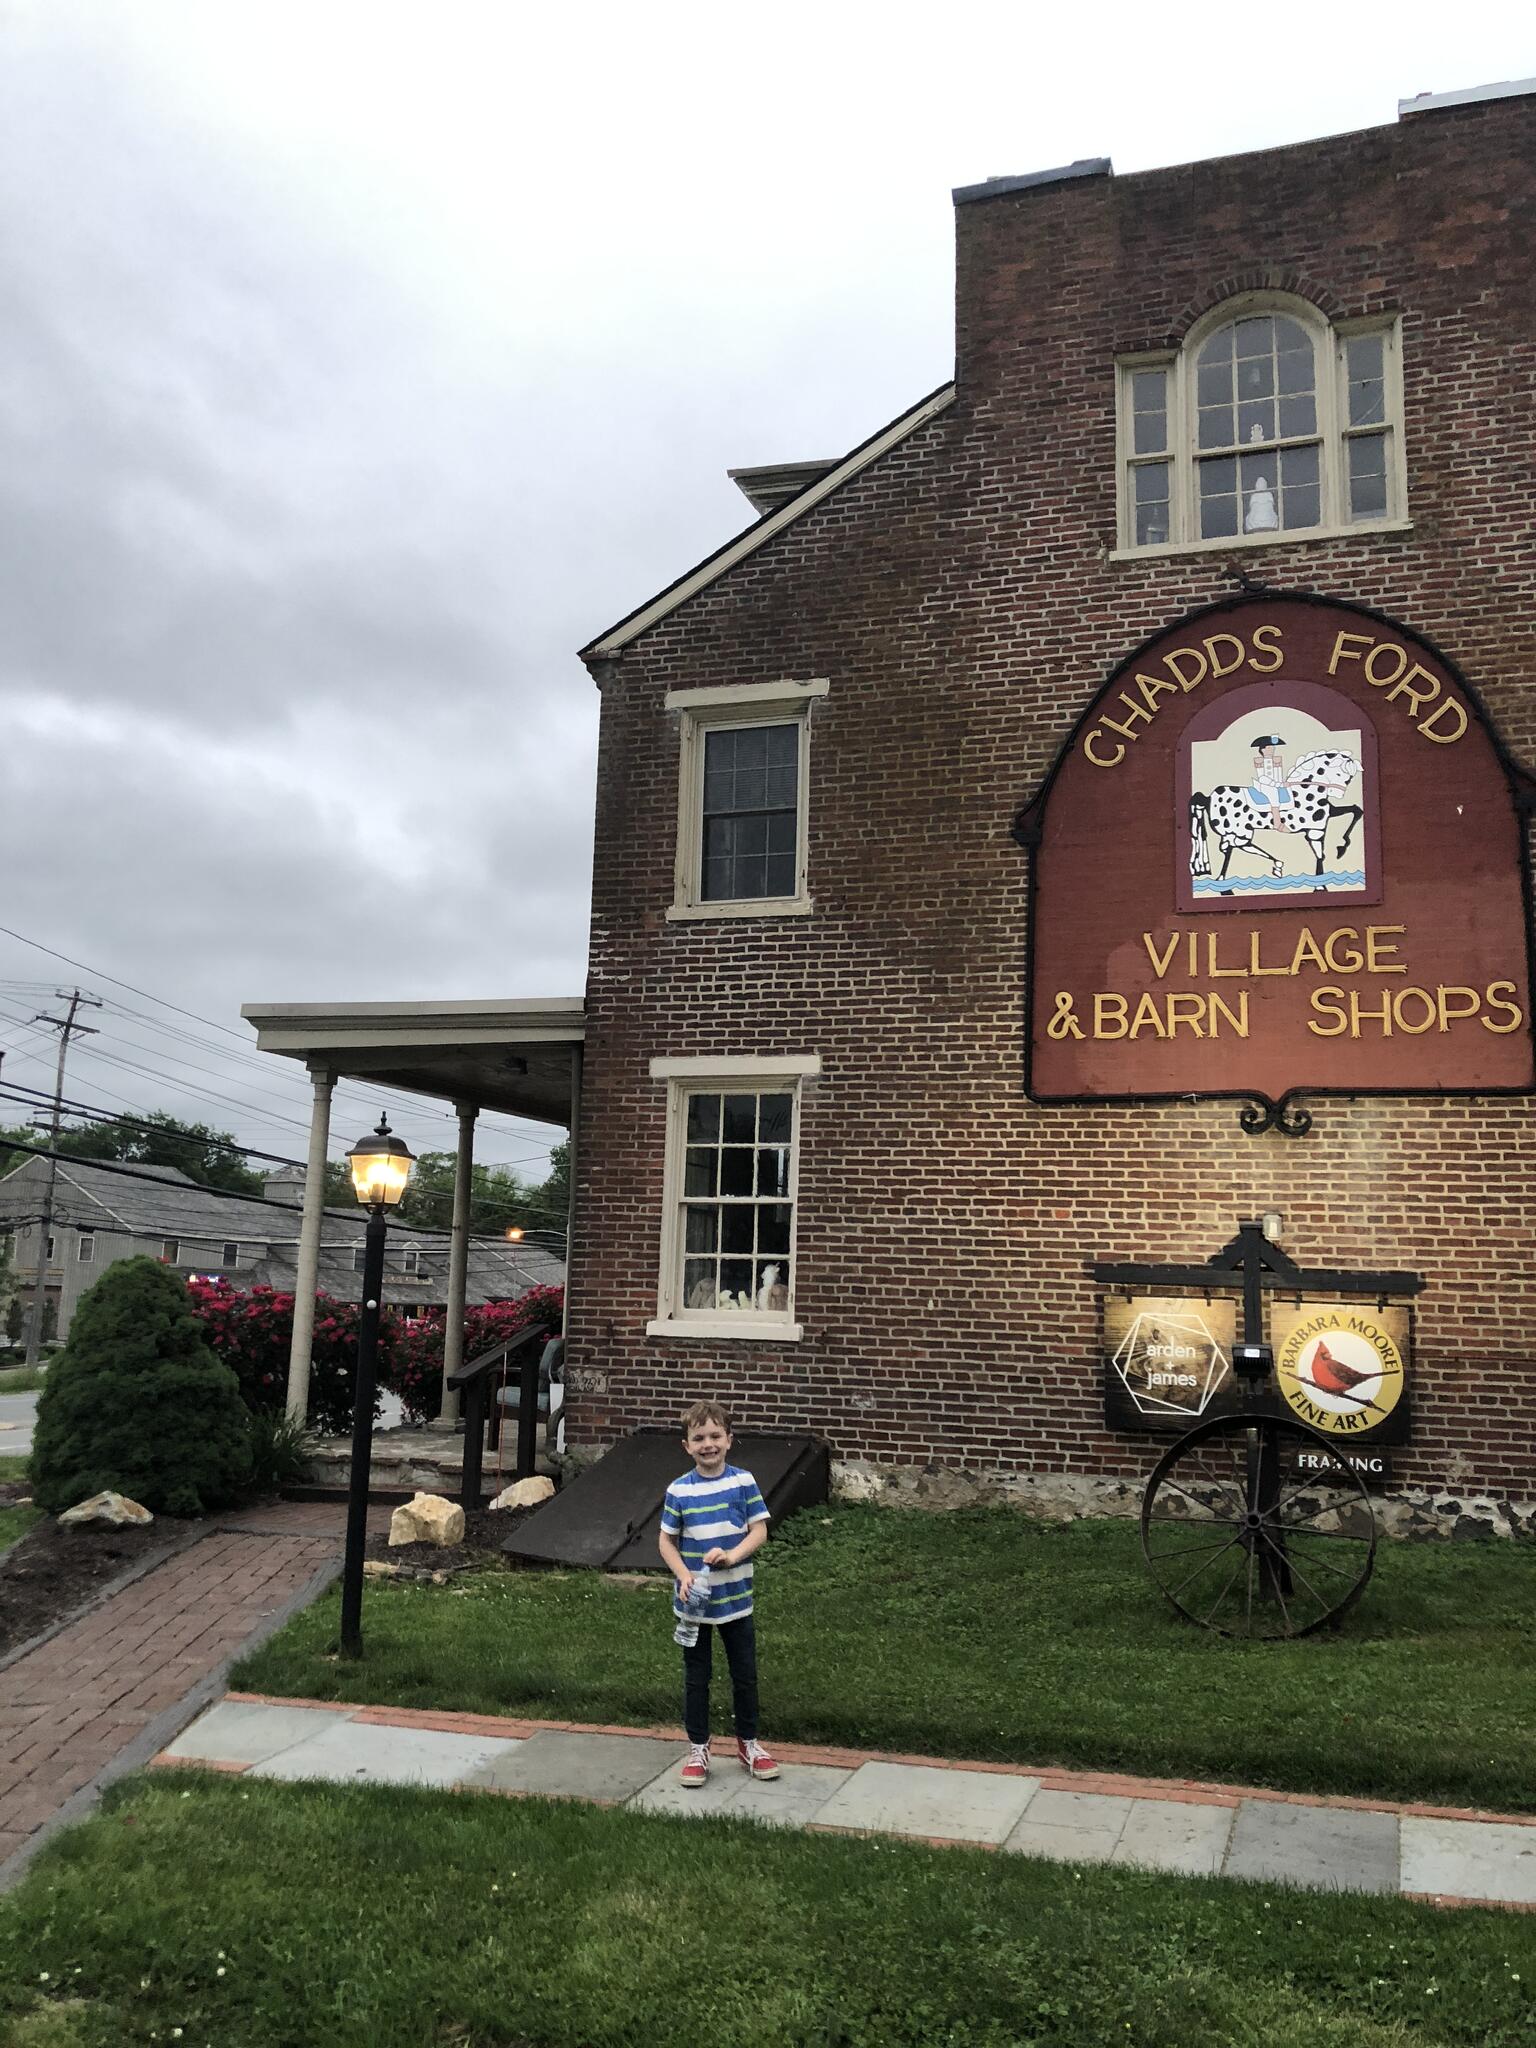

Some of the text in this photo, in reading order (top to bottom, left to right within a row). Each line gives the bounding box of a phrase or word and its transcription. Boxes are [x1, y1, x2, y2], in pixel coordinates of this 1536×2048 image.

[1083, 625, 1469, 767] CHADDS FORD
[1143, 924, 1408, 979] VILLAGE
[1306, 980, 1524, 1039] SHOPS
[1146, 1335, 1196, 1358] arden
[1282, 1315, 1399, 1369] BARBARA MOORE
[1146, 1367, 1198, 1390] james
[1289, 1390, 1369, 1430] FINE ART
